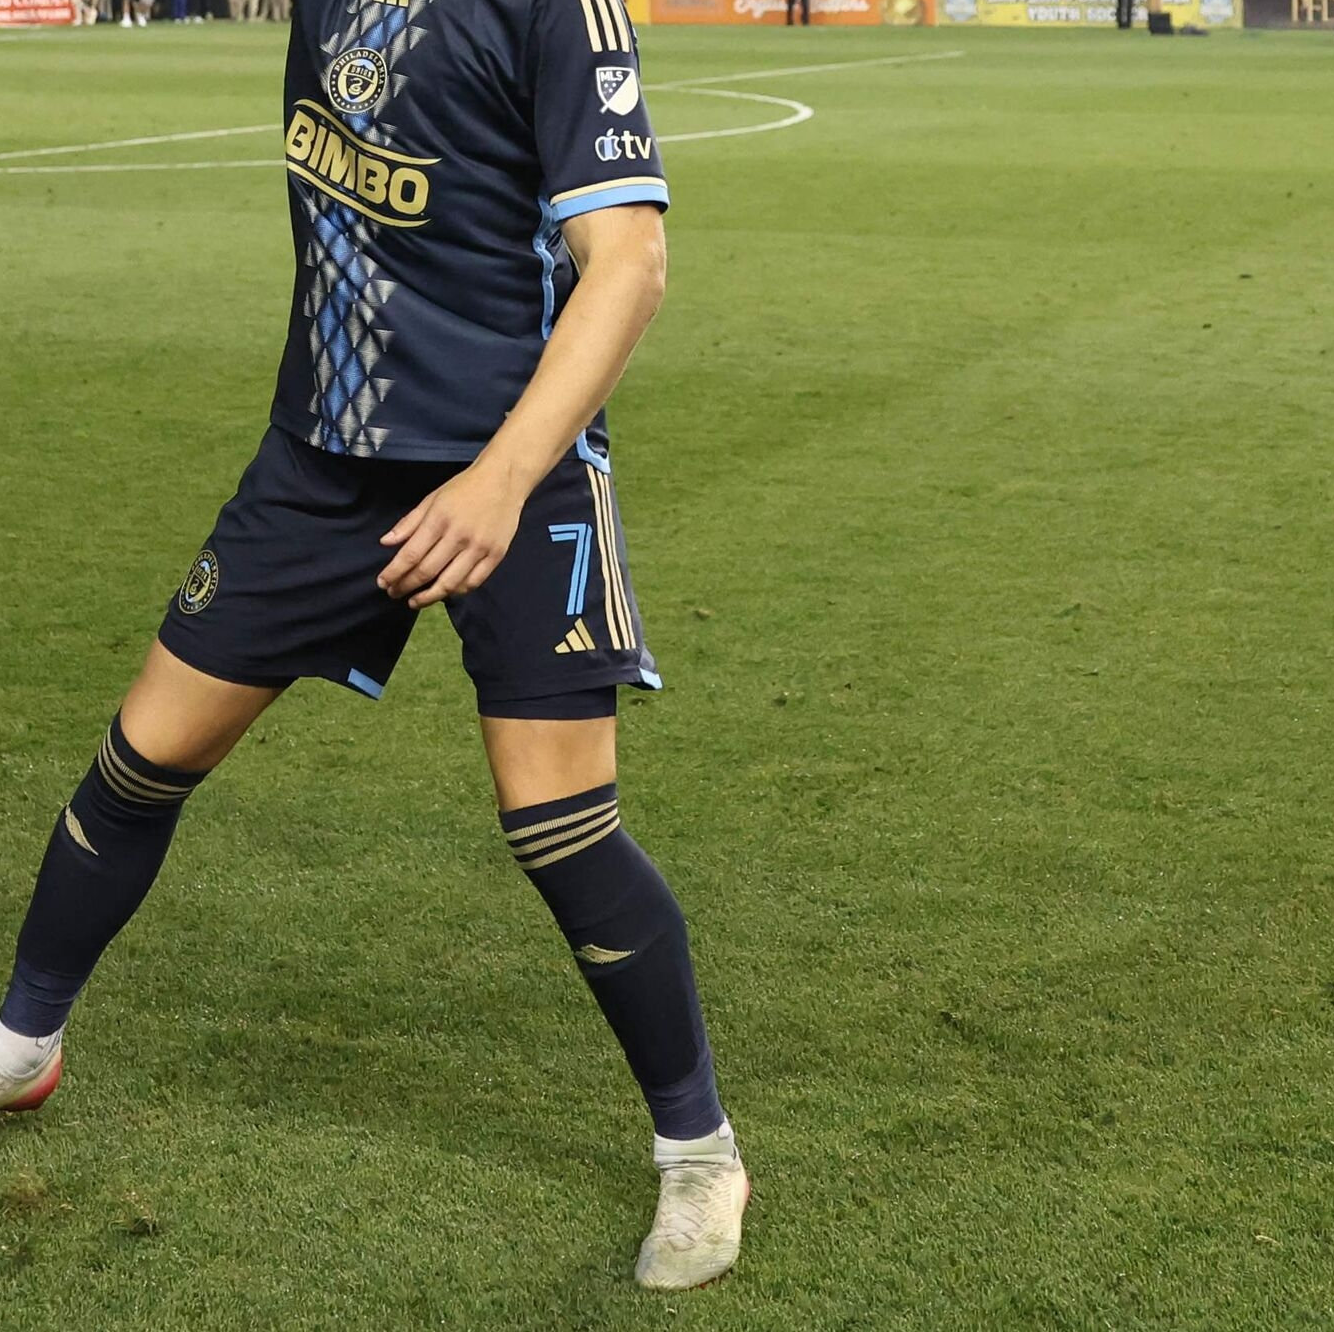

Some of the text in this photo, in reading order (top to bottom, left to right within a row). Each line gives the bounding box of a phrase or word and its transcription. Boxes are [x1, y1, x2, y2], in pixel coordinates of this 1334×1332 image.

[1028, 6, 1081, 21] YOUTH
[334, 50, 386, 85] PHILADELPHIA
[350, 64, 373, 78] UNION
[600, 70, 624, 82] MLS
[621, 130, 652, 159] tv
[286, 109, 430, 216] BIMBO
[548, 522, 593, 616] 7
